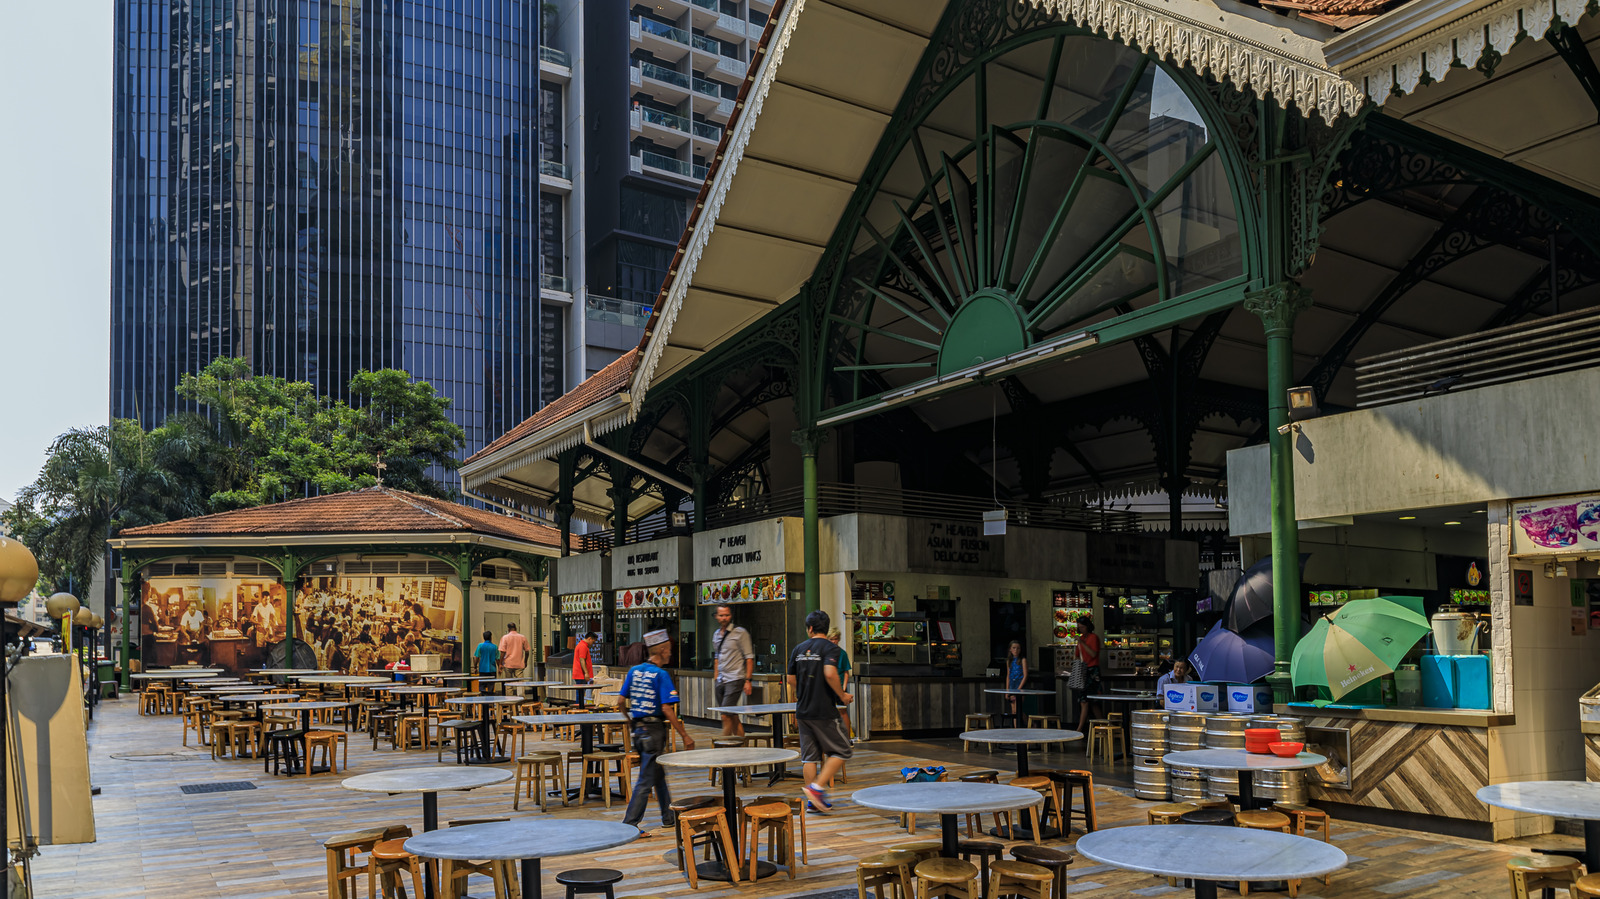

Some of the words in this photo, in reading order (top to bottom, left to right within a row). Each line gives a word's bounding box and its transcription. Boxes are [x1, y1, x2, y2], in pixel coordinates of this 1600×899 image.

[946, 524, 978, 537] HEAVEN
[727, 534, 747, 548] HEAVEN
[927, 536, 953, 549] ASIAN
[960, 538, 990, 552] FUSION
[722, 553, 744, 566] CHICKEN
[745, 550, 762, 563] WINGS
[933, 550, 979, 563] DELICACIES
[1340, 665, 1375, 689] Heineken
